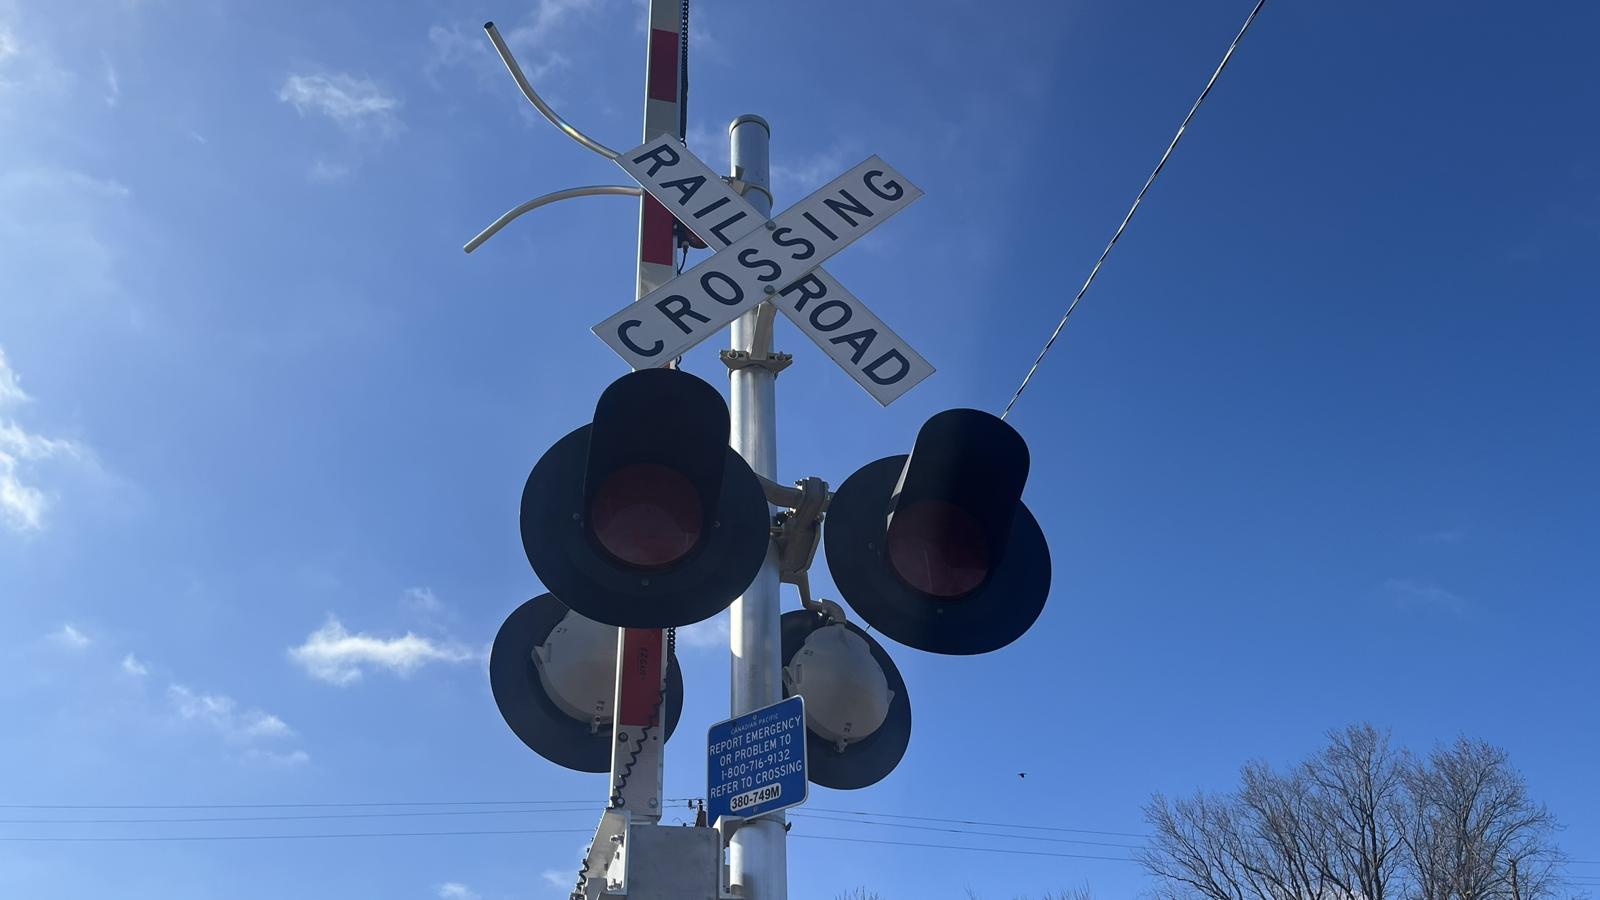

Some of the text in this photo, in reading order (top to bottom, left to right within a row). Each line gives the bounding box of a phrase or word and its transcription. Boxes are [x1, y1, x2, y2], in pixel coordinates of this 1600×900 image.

[617, 170, 904, 357] CROSSING
[632, 143, 911, 386] RAIL ROAD
[709, 715, 801, 756] REPORT EMERGENCY
[731, 721, 757, 735] CANADIAN
[720, 733, 791, 767] OR PROBLEM TO
[721, 749, 790, 781] 1-800-716-9132
[710, 760, 802, 799] REFER TO CROSSING
[731, 785, 780, 809] 380-749M
